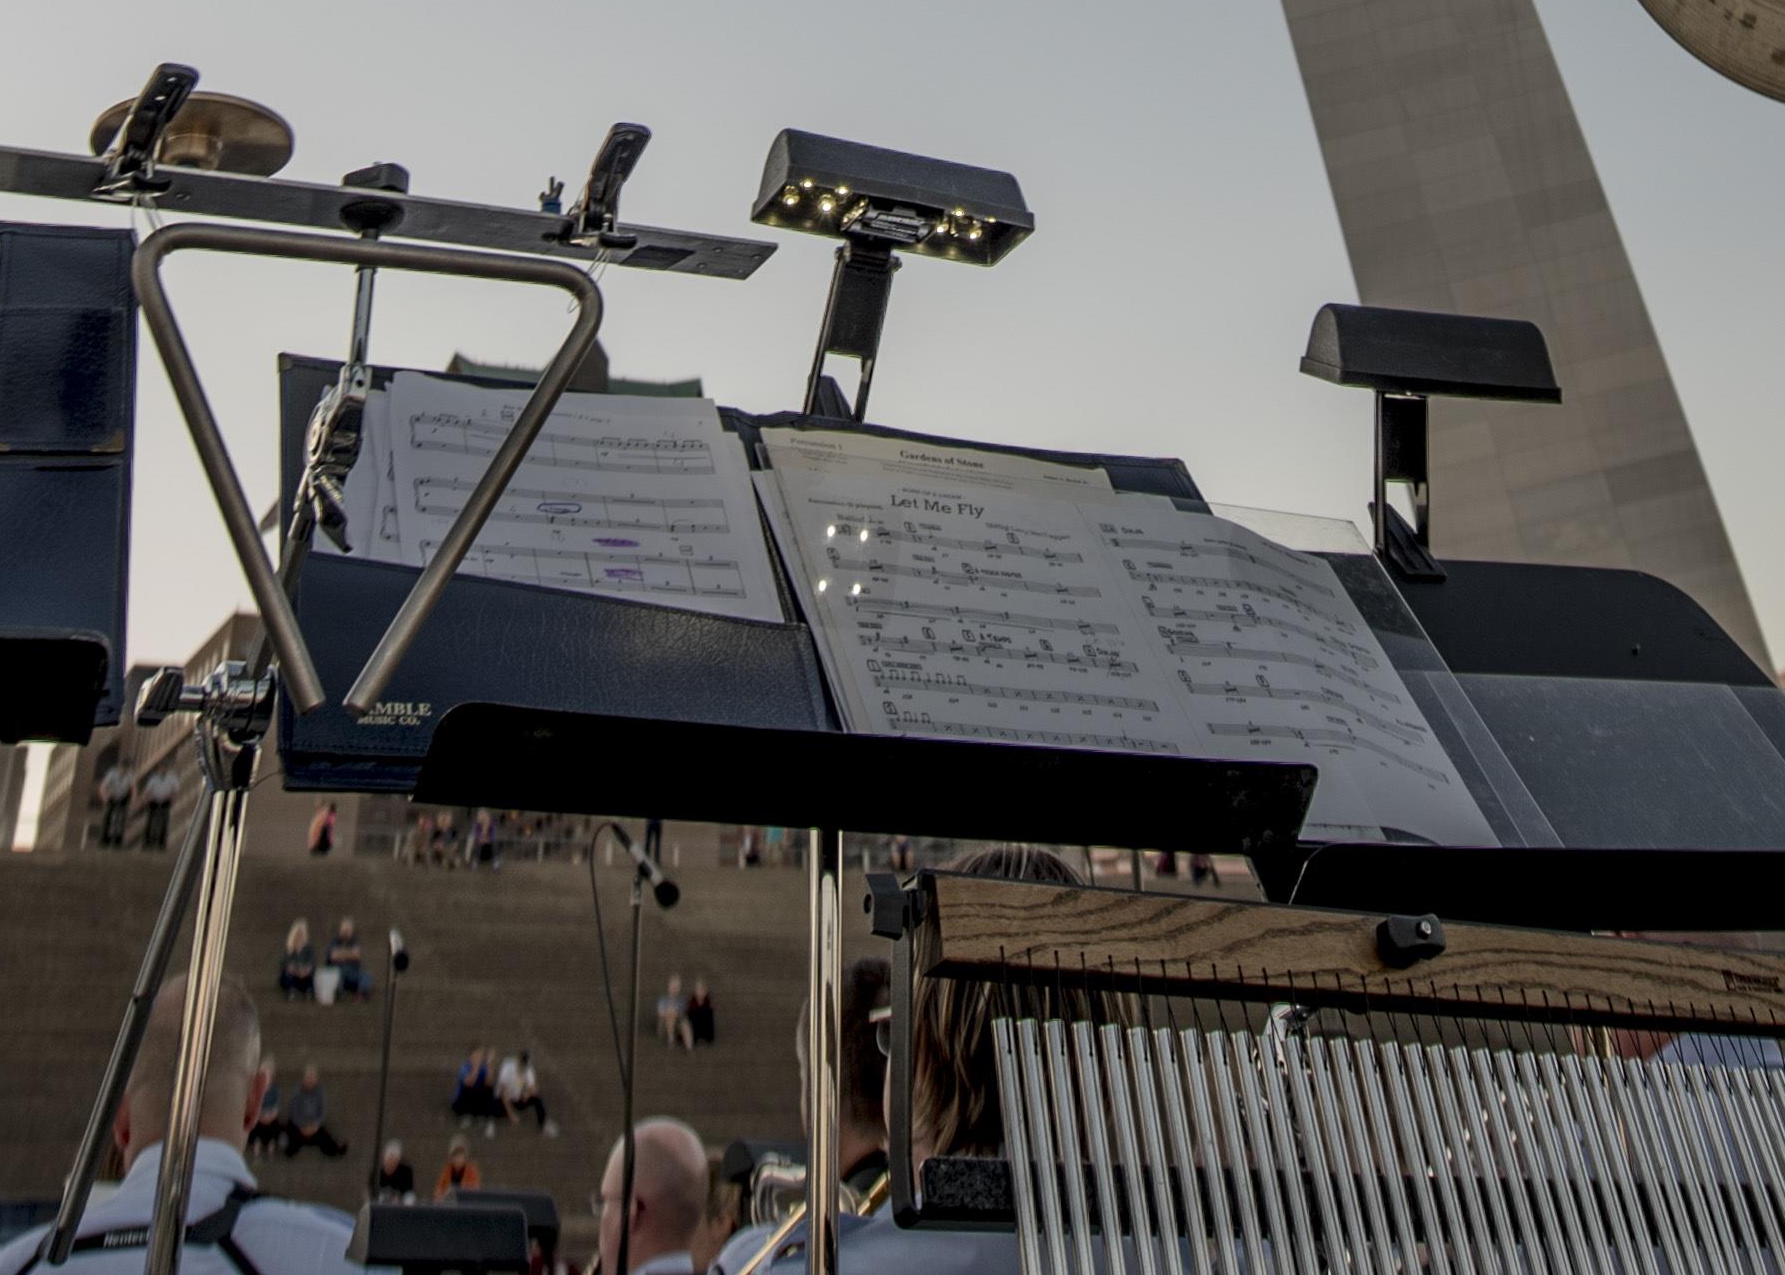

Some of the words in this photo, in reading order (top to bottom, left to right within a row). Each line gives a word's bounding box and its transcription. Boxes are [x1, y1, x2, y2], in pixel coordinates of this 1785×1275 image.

[899, 449, 942, 463] Gardens
[889, 494, 918, 509] Let
[924, 498, 952, 514] Me
[957, 503, 985, 519] Fly
[368, 702, 433, 717] MBLE
[399, 716, 422, 727] CO.
